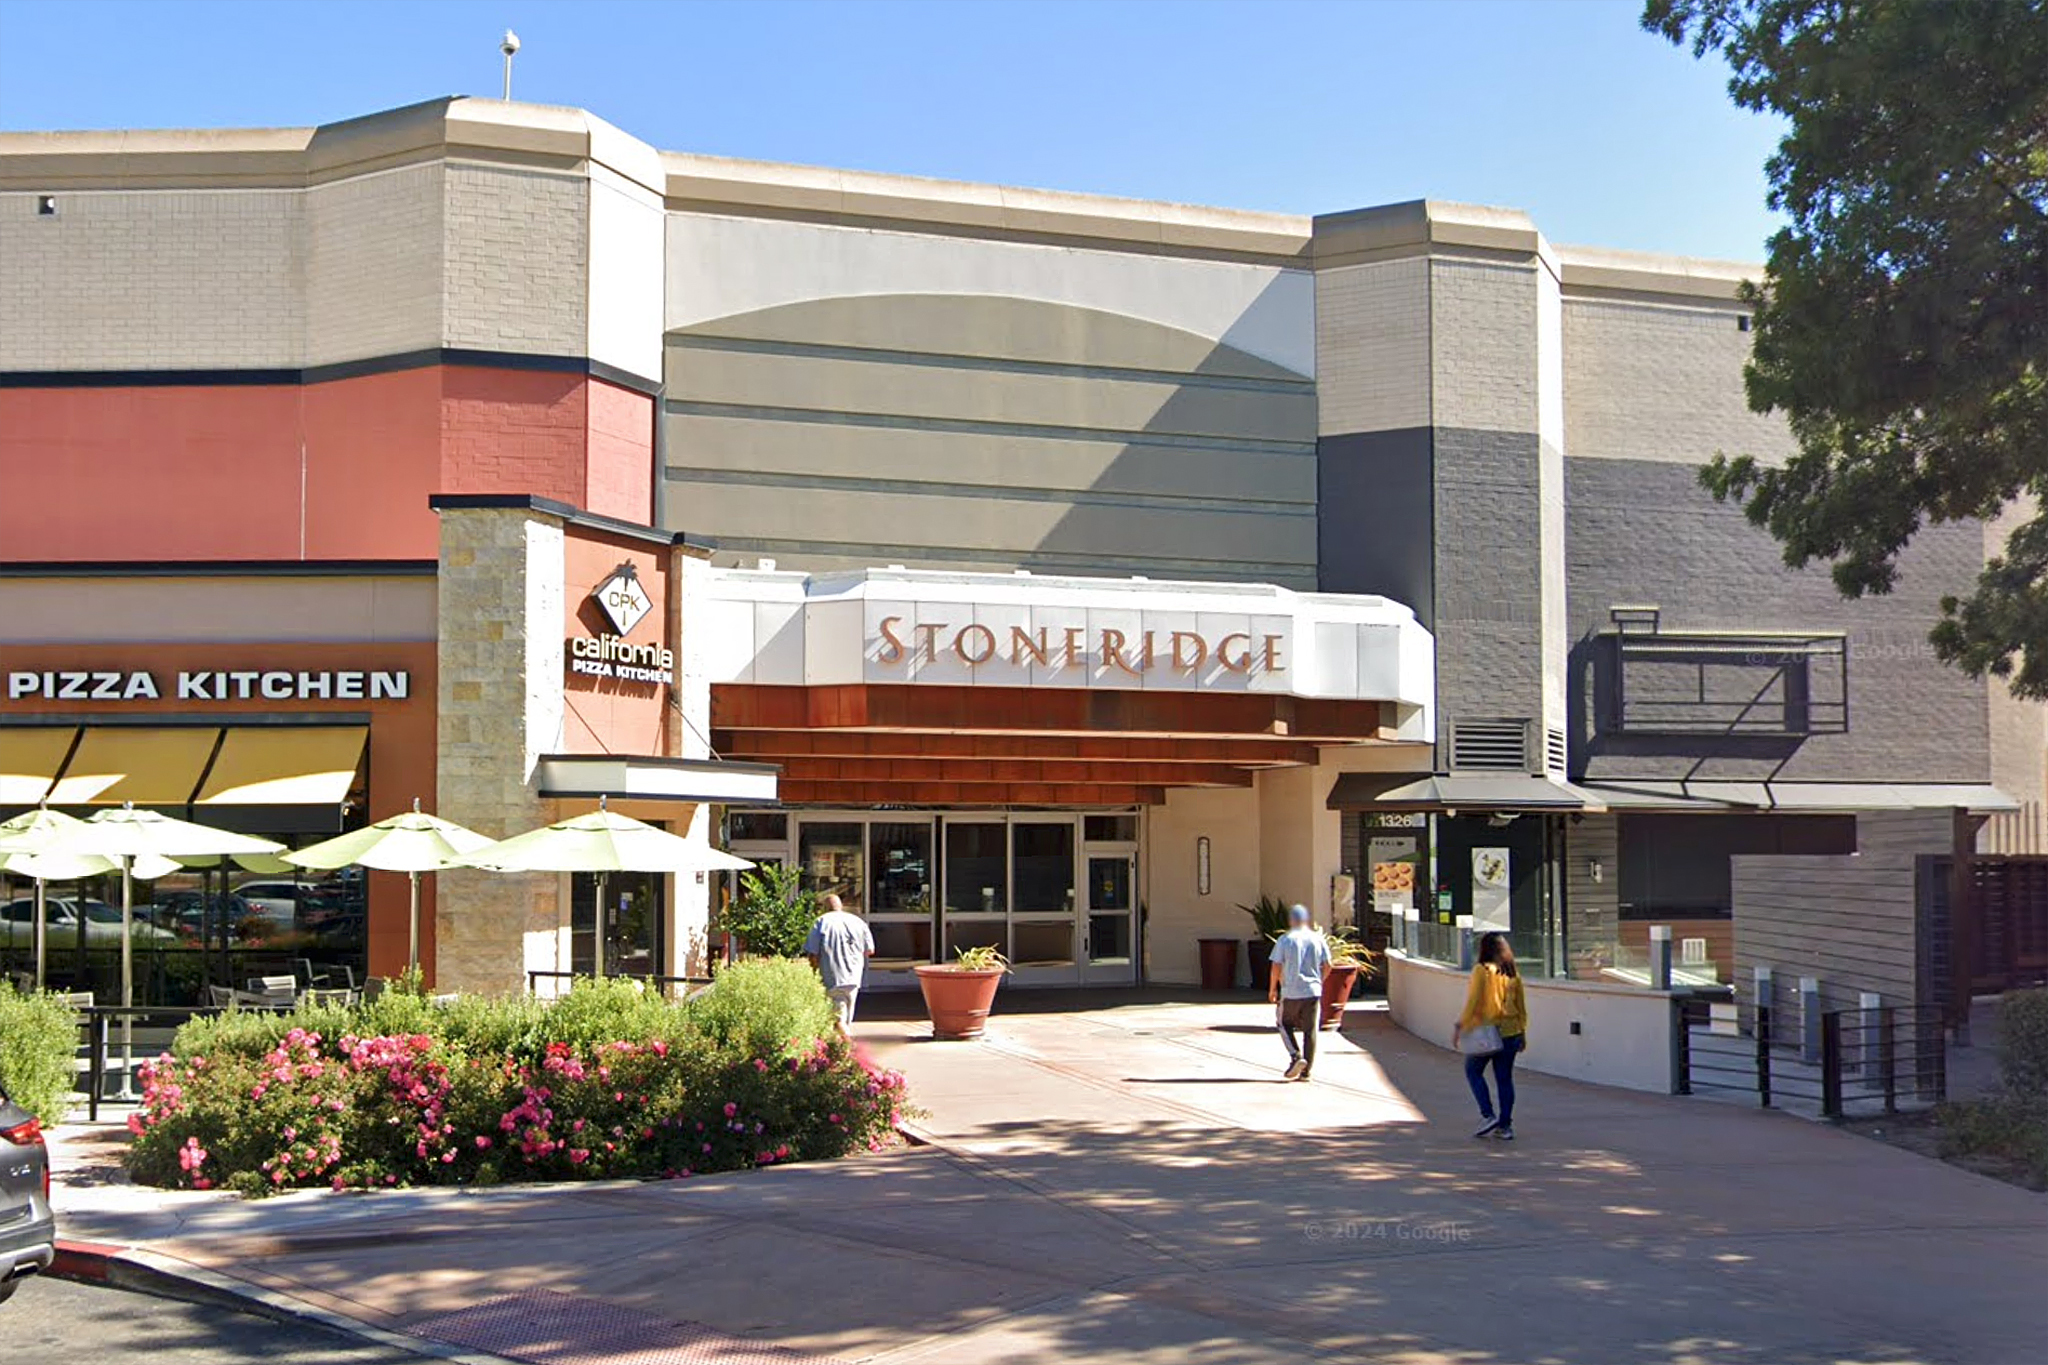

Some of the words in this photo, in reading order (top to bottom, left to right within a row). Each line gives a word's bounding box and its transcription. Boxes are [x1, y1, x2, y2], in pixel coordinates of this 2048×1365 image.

[608, 591, 641, 612] CPK
[877, 615, 1288, 676] STONERIDGE
[572, 659, 613, 677] PIZZA
[615, 664, 674, 684] KITCHEN
[8, 671, 159, 699] PIZZA
[177, 671, 409, 699] KITCHEN
[1378, 814, 1413, 828] 1326
